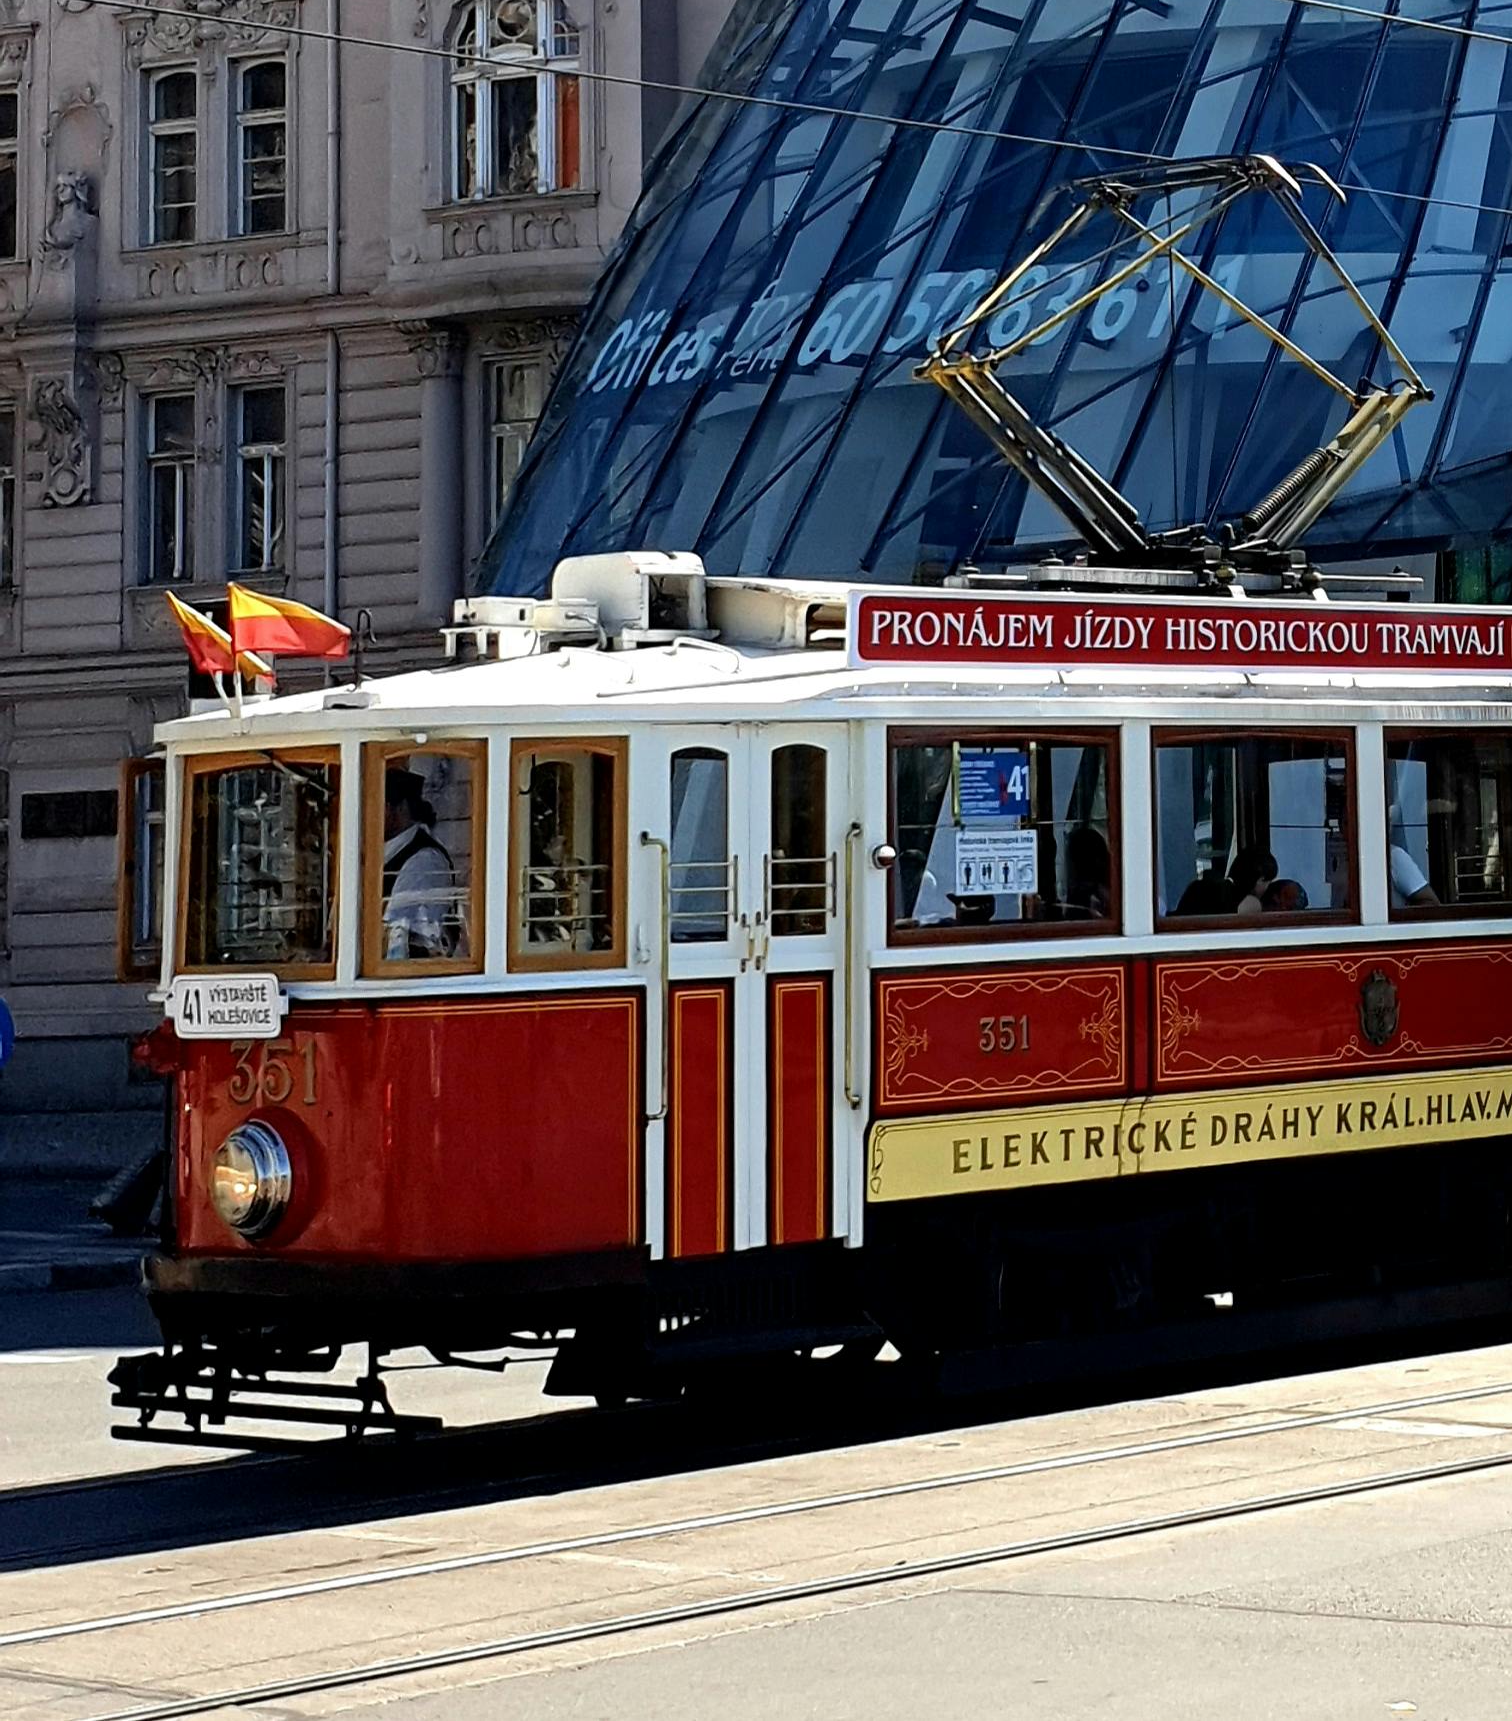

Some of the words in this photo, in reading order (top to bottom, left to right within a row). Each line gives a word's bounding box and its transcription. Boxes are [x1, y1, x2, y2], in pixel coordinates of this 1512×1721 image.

[870, 606, 1055, 648] PRONÁJEM
[1063, 608, 1154, 650] JÍZDY
[1165, 617, 1369, 654] HISTORICKOU
[1376, 620, 1505, 657] TRAMVAJÍ
[1006, 764, 1030, 801] 41
[183, 988, 202, 1025] 41
[979, 1014, 1030, 1052] 351
[229, 1032, 317, 1105] 351
[951, 1111, 1198, 1174] ELEKTRICKÉ
[1210, 1102, 1324, 1147] DRÁHY
